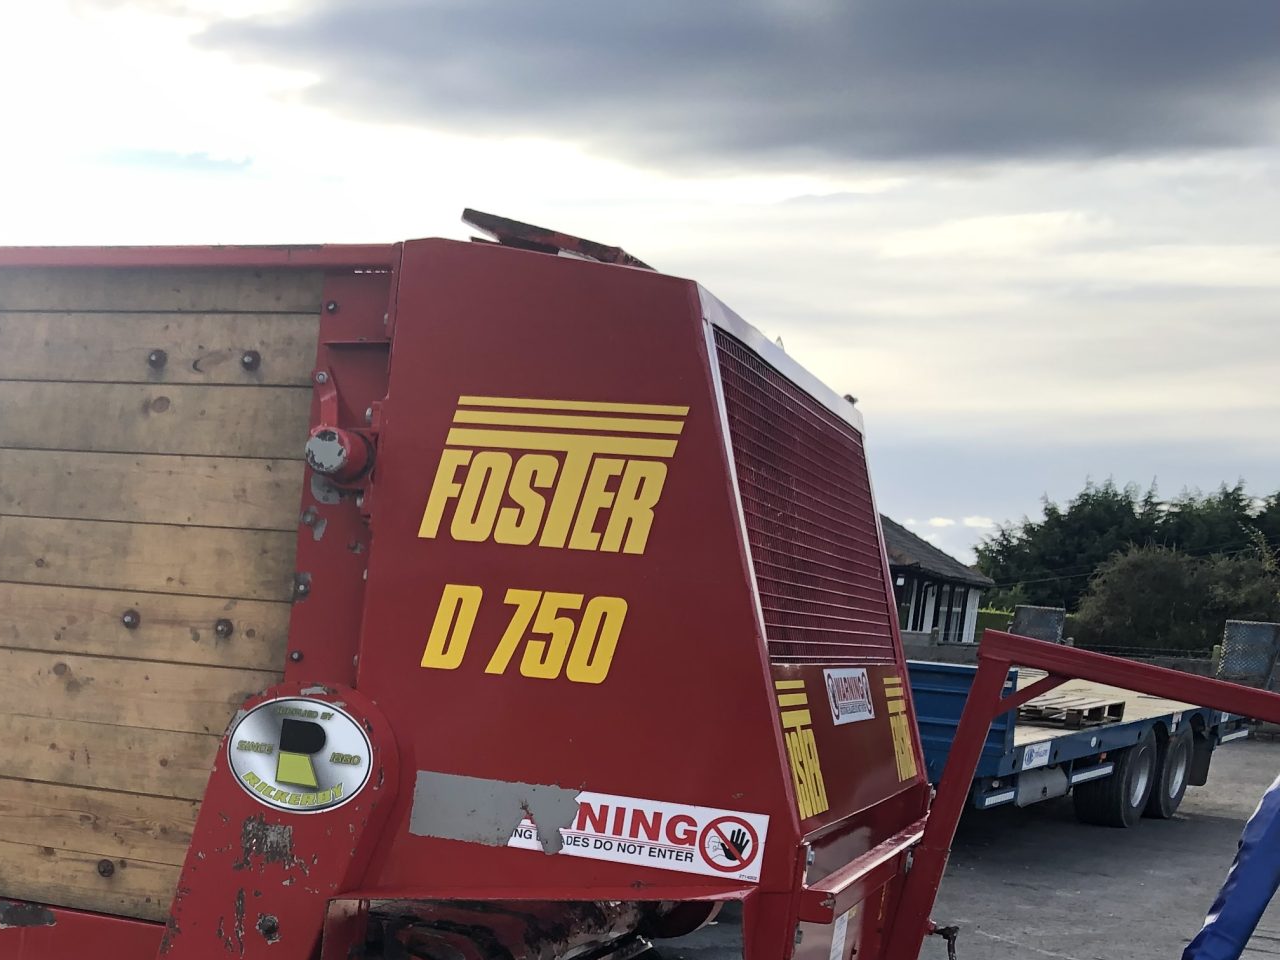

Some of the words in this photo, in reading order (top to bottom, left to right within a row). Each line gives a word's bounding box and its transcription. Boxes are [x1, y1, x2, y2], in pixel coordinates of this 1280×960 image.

[418, 428, 678, 554] FOSTER
[421, 584, 483, 670] D
[484, 588, 628, 684] 750
[241, 771, 344, 806] RICKERBY
[510, 829, 533, 839] NG
[593, 839, 614, 850] DO
[617, 843, 645, 855] NOT
[648, 846, 695, 862] ENTER
[576, 801, 698, 847] NING
